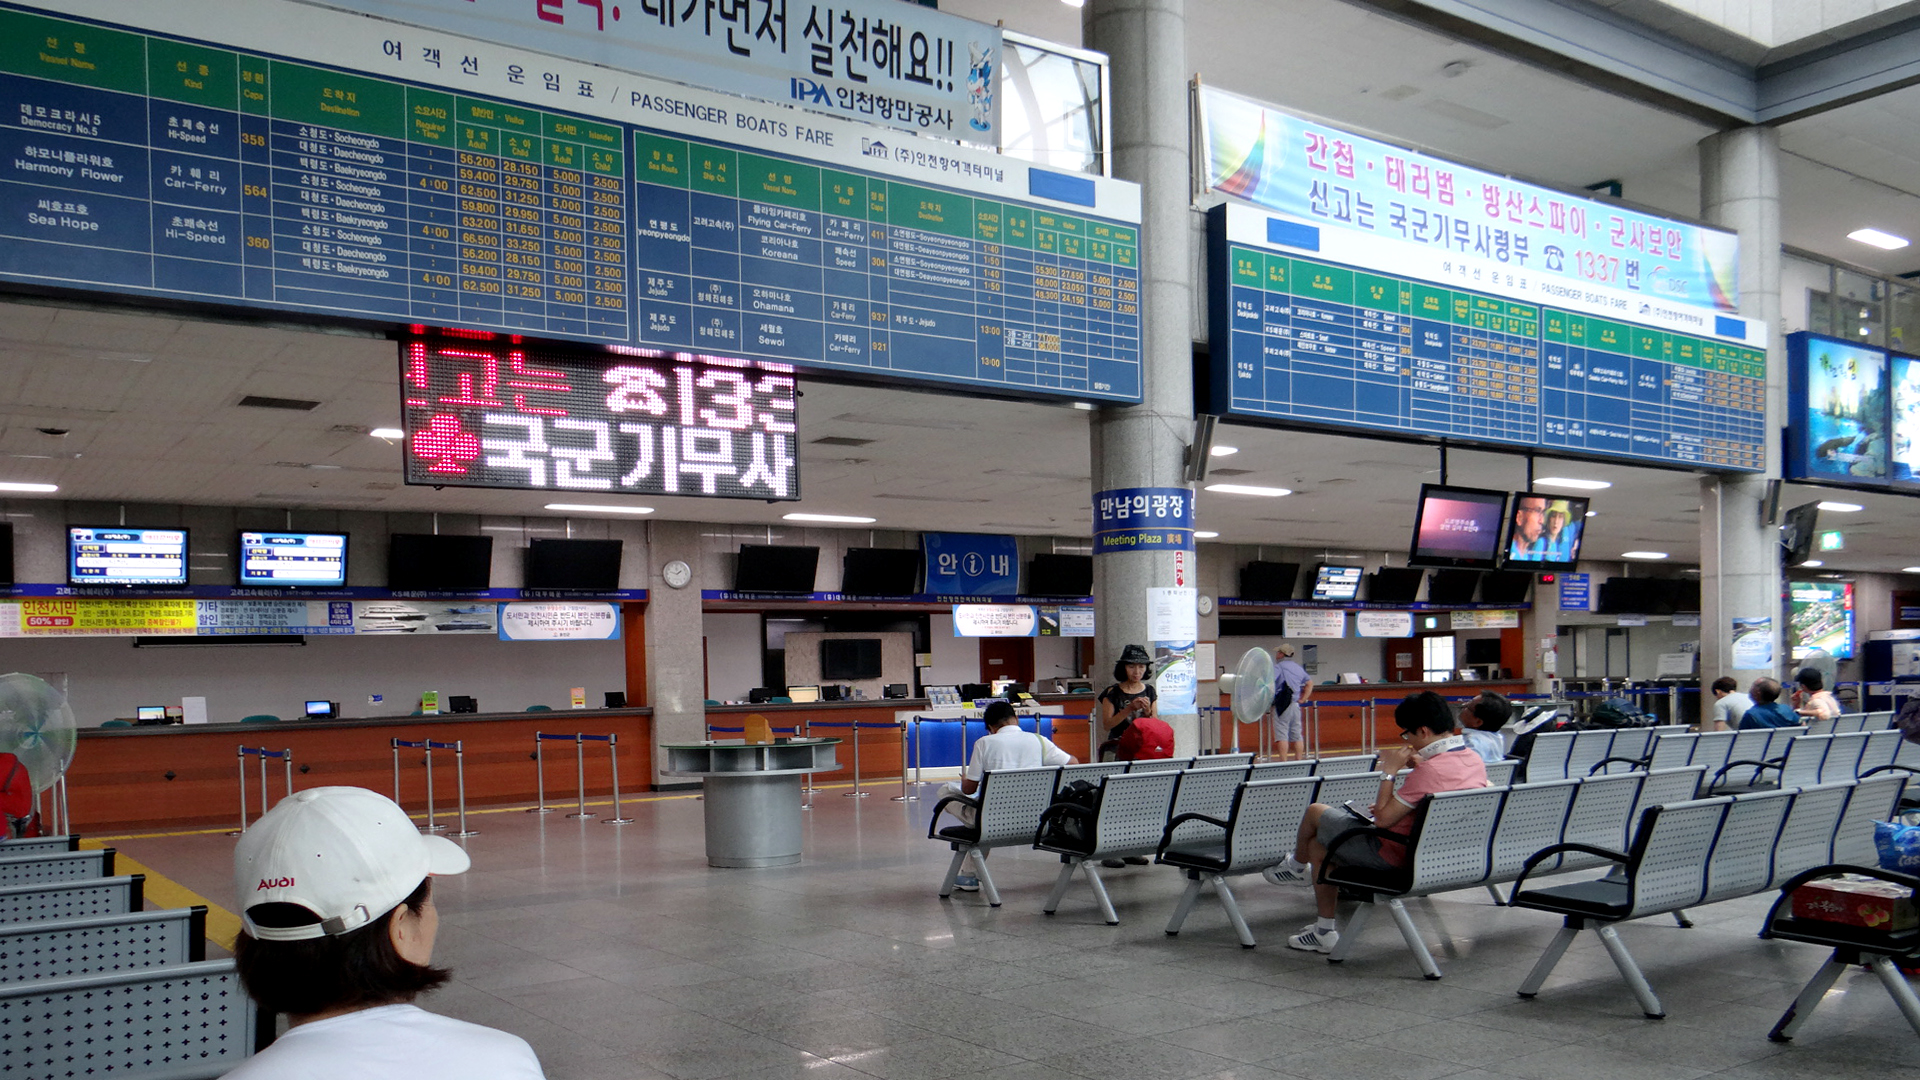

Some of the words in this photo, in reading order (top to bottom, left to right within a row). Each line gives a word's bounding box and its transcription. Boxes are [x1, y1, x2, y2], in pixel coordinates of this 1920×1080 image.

[802, 4, 954, 92] 실천해요!!
[790, 77, 834, 107] IPA
[836, 86, 954, 131] 인천항만공사
[21, 115, 72, 133] Democracy
[631, 91, 728, 125] PASSENGER
[736, 113, 788, 138] BOATS
[795, 126, 834, 147] FARE
[168, 129, 206, 144] Hi-Speed
[241, 133, 265, 147] 358
[334, 131, 380, 148] Socheongdo
[25, 146, 114, 168] 하모니플라워호
[334, 146, 384, 164] Daecheongdo
[15, 159, 74, 178] Harmony
[81, 168, 124, 182] Flower
[334, 163, 387, 181] Baekryeongdo
[894, 146, 1004, 184] (주)인천항여객터미널
[164, 177, 227, 195] Car-Ferry
[244, 184, 267, 198] 564
[335, 180, 381, 196] Socheongdo
[1304, 131, 1355, 179] 간첩
[1384, 155, 1454, 207] 테러범
[1482, 183, 1586, 240] 방산스파이
[1610, 216, 1682, 260] 군사보안
[335, 196, 385, 213] Daecheongdo
[28, 213, 57, 226] Sea
[61, 216, 99, 231] Hope
[336, 212, 388, 230] Baekryeongdo
[748, 215, 771, 228] Flying
[774, 220, 811, 235] Car-Ferry
[165, 228, 226, 244] Hi-Speed
[247, 236, 269, 249] 360
[337, 229, 382, 245] Socheongdo
[826, 227, 865, 242] Car-Ferry
[1308, 180, 1375, 230] 신고는
[1389, 201, 1529, 266] 국군기무사령부
[1574, 249, 1621, 283] 1337
[1625, 259, 1640, 291] 번
[337, 246, 387, 262] Daecheongdo
[761, 247, 799, 260] Koreana
[337, 262, 389, 279] Baekryeongdo
[1541, 282, 1582, 301] PASSENGER
[1585, 292, 1608, 306] BOATS
[1610, 297, 1628, 310] FARE
[752, 300, 795, 313] Ohamana
[871, 311, 887, 322] 937
[759, 323, 783, 335] 세월호
[758, 335, 785, 347] Sewol
[872, 341, 887, 352] 921
[481, 413, 794, 497] 국군기무사
[1100, 495, 1184, 520] 만남의광장
[1103, 533, 1136, 546] Meeting
[1139, 533, 1162, 544] Plaza
[22, 600, 77, 616] 인천시민
[198, 601, 218, 612] 기타
[30, 617, 52, 625] 50%
[198, 614, 218, 626] 할인
[257, 876, 295, 891] AUDI
